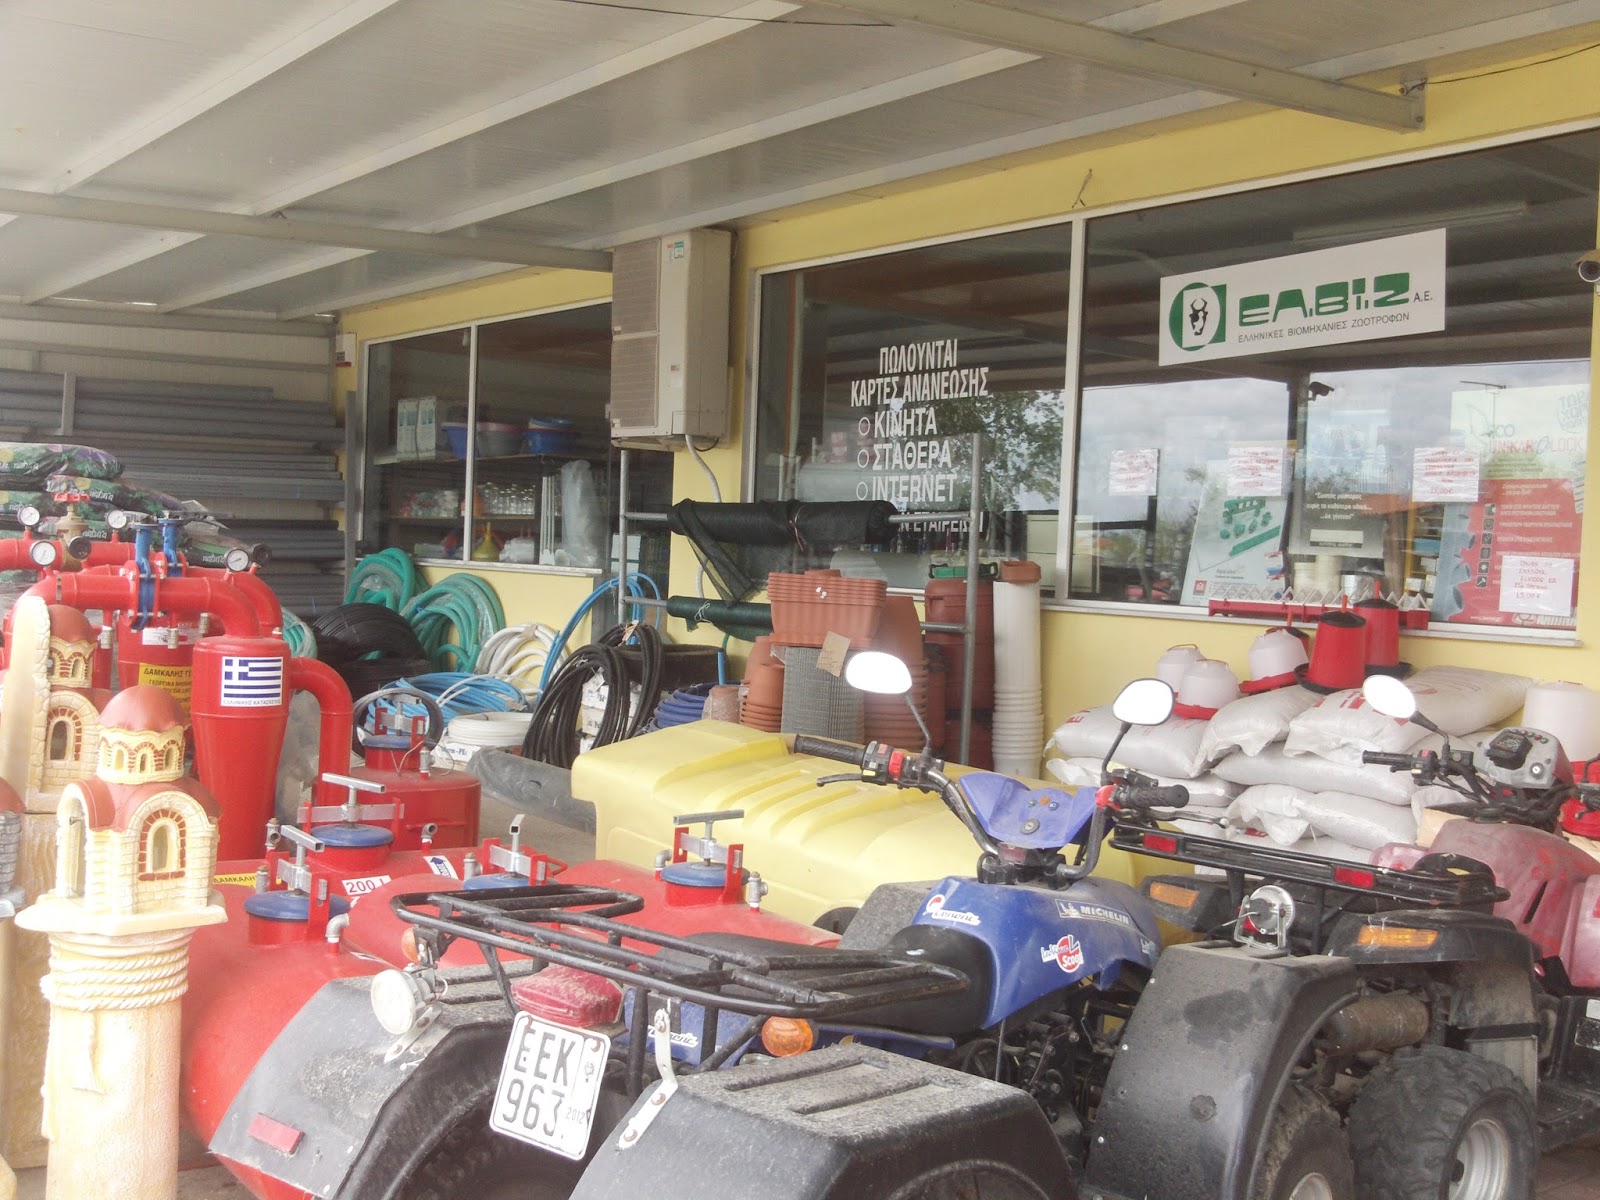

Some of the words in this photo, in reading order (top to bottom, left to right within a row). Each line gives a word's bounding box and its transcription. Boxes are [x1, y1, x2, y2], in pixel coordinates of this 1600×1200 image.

[1413, 290, 1433, 304] Α.Ε.
[1237, 329, 1284, 343] ΕΛΛΗΝΙΚΕΣ
[1287, 320, 1347, 337] ΒΙΟΜΗΧΑΝΙΕΣ
[1351, 312, 1410, 328] ΖΩΟΤΡΟΦΩΝ
[879, 338, 958, 375] ΠΩΛΟΥΝΤΑΙ
[850, 376, 900, 407] ΚΑΡΤΕΣ
[903, 367, 989, 403] ΑΝΑΝΕΩΣΗΣ
[873, 407, 938, 438] ΚΙΝΗΤΑ
[872, 439, 952, 471] ΣΤΑΘΕΡΑ
[872, 473, 957, 503] INTERNET
[144, 667, 183, 678] ΔΑΜΚΑΛΗΣ
[345, 880, 376, 893] 200
[1081, 905, 1130, 925] MICHELIN
[514, 1026, 577, 1087] EEK
[502, 1077, 565, 1137] 963
